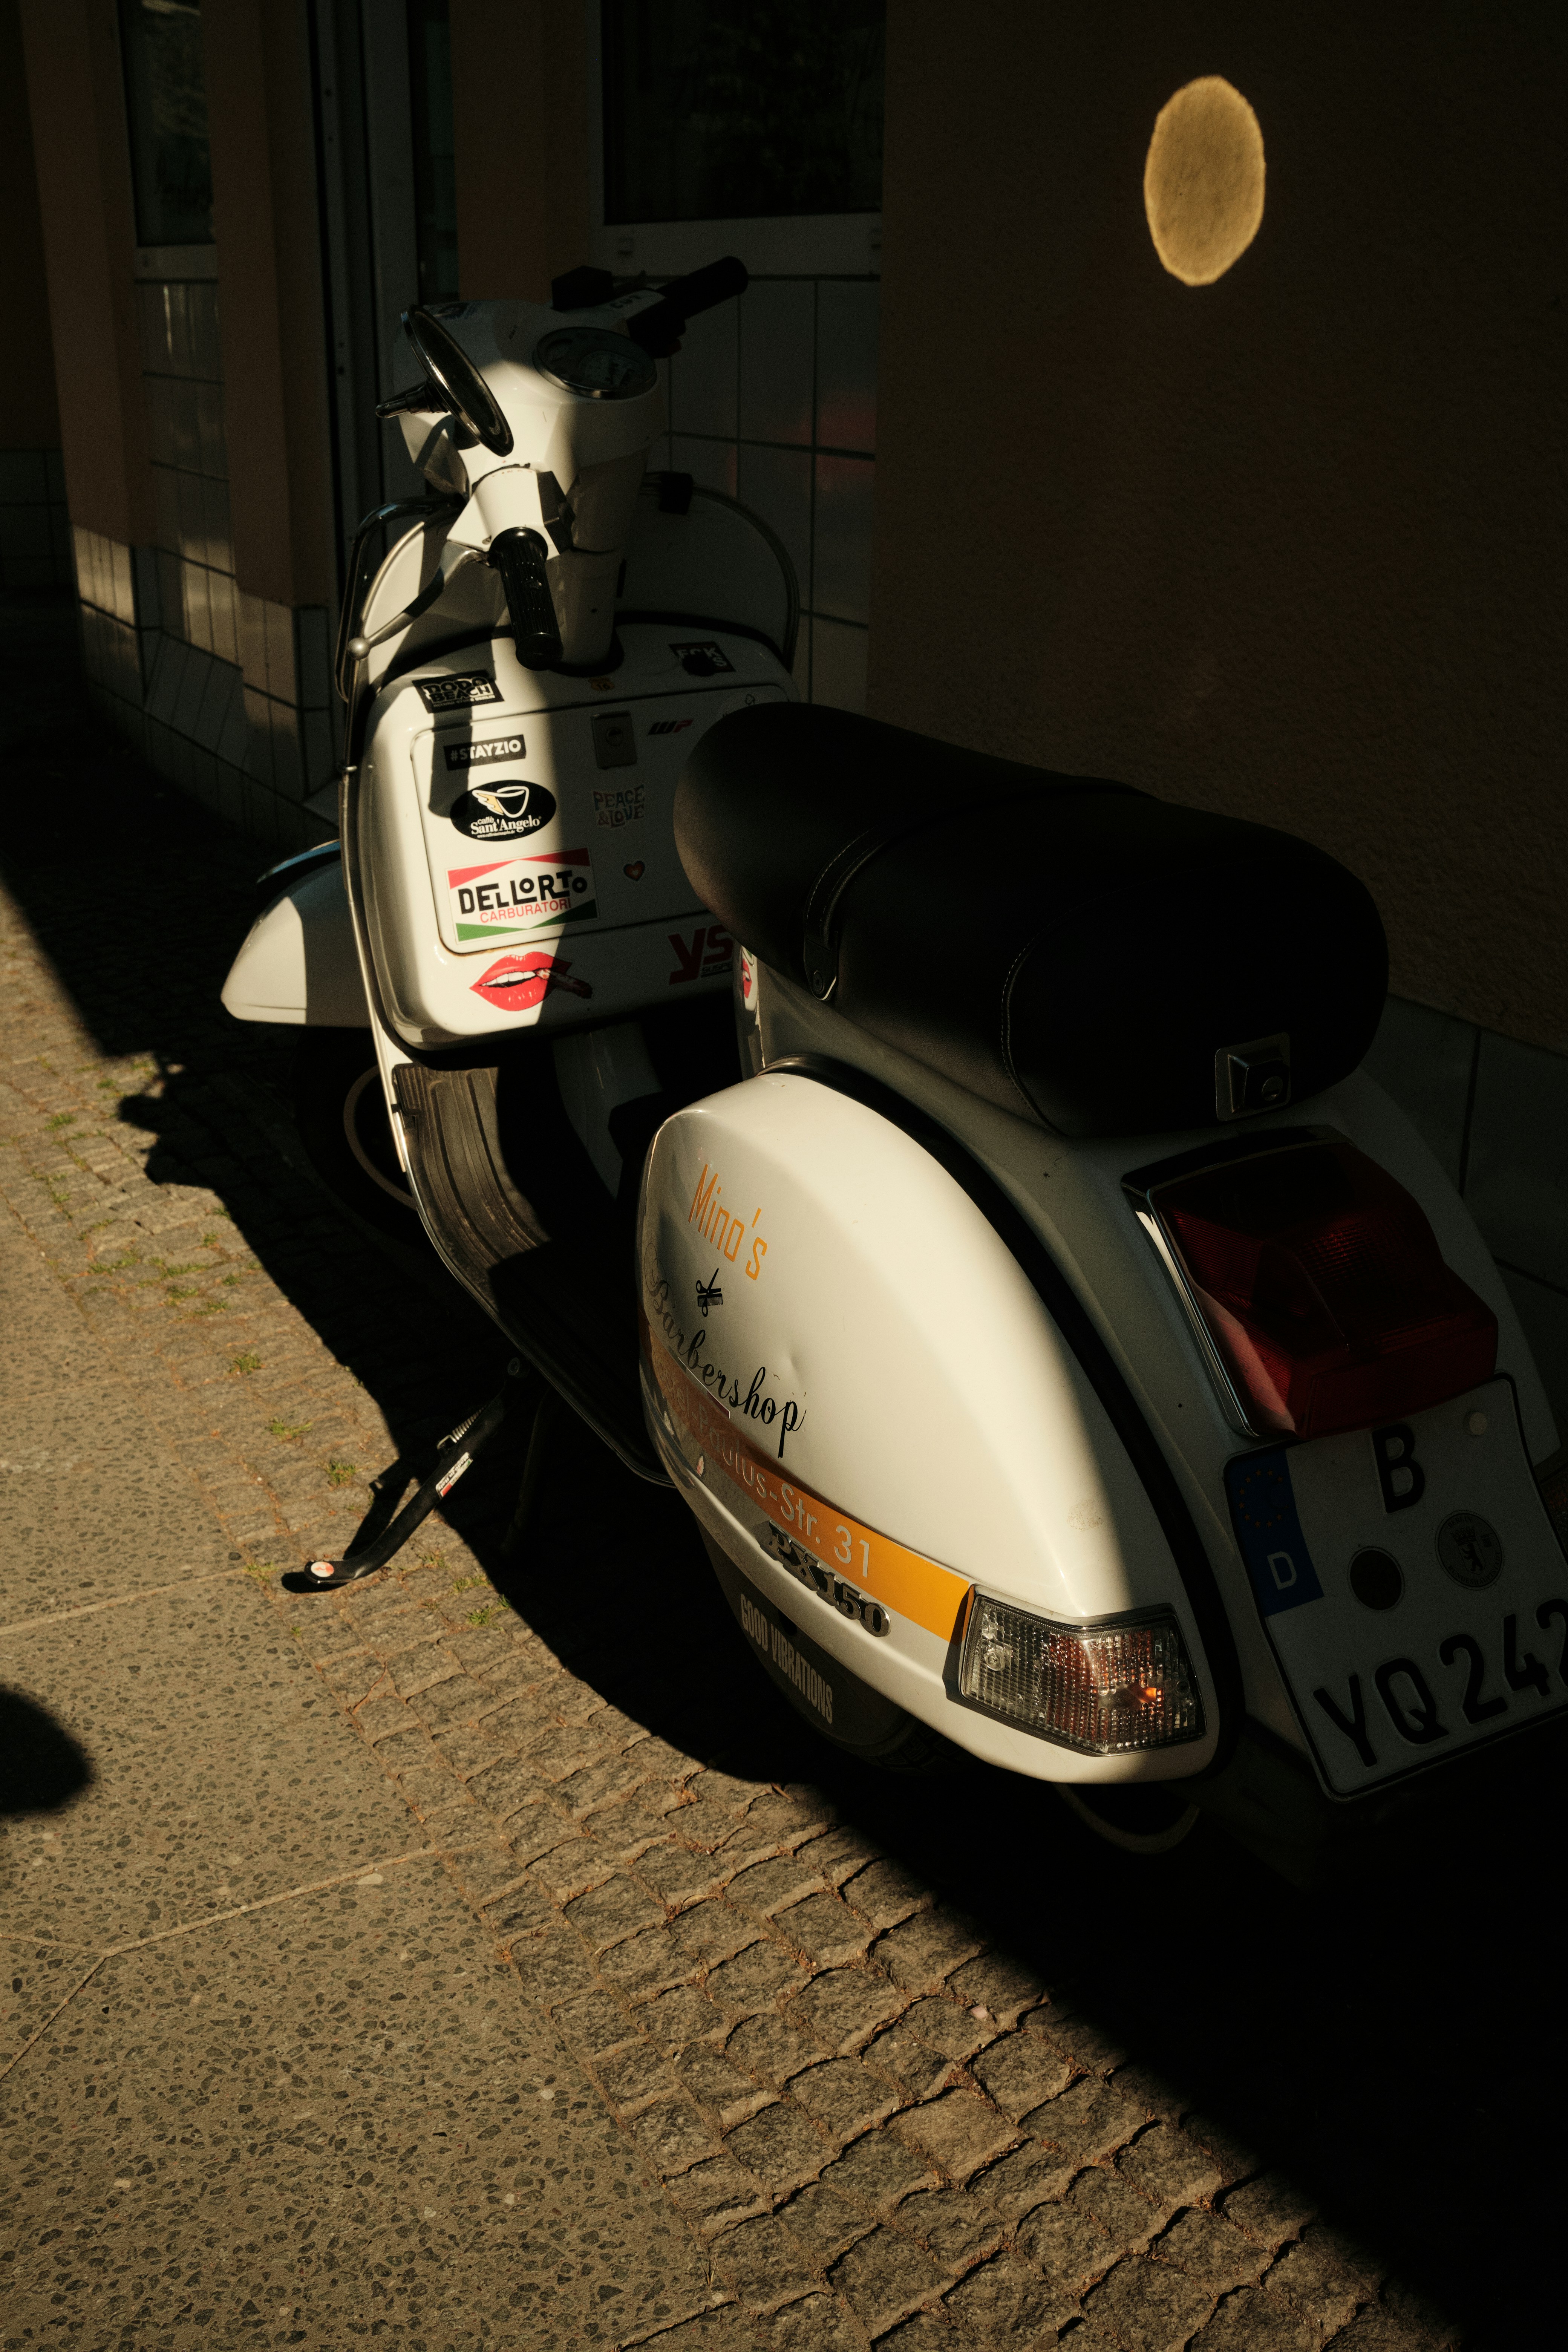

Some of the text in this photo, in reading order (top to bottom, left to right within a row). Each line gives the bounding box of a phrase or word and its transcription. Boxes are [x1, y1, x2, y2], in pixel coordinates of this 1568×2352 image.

[421, 676, 488, 694] DODO
[430, 686, 491, 702] BEACH
[648, 719, 693, 735] WP
[450, 739, 522, 762] #STAYZIO
[593, 784, 645, 811] PEACE
[470, 815, 541, 835] Sant'Angelo
[458, 870, 588, 914] DELLORTO
[480, 898, 571, 923] CARBURATORI
[689, 1163, 767, 1281] Mino's
[644, 1243, 807, 1458] Barbershop
[1372, 1423, 1426, 1513] B
[1448, 1515, 1472, 1528] BERLIN
[834, 1525, 870, 1578] 31
[1447, 1550, 1501, 1585] BUNDESHAUPTSTADT
[1267, 1551, 1297, 1590] D
[740, 1593, 769, 1652] GOOD
[770, 1622, 833, 1724] VIBRATIONS
